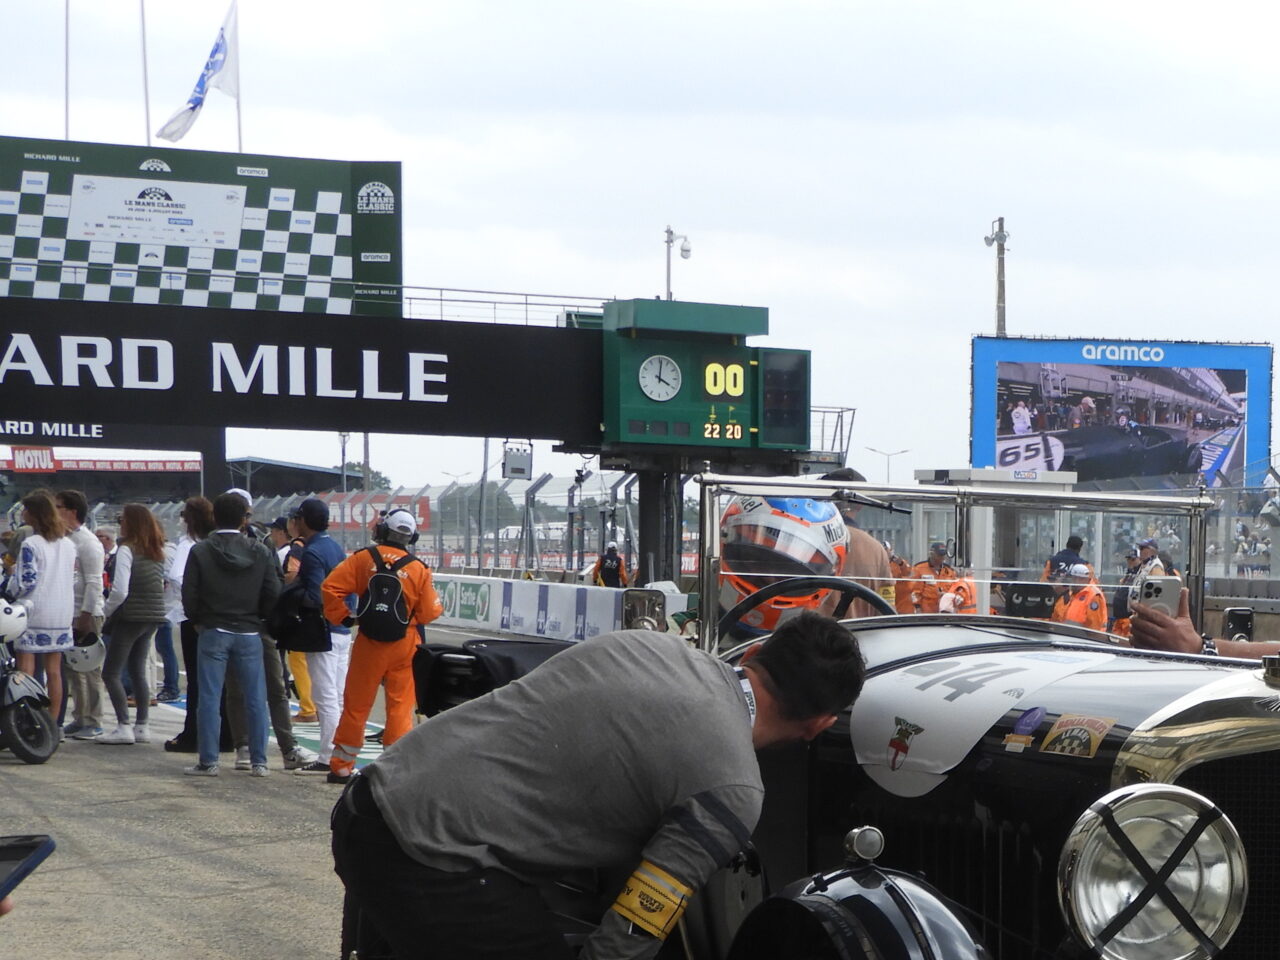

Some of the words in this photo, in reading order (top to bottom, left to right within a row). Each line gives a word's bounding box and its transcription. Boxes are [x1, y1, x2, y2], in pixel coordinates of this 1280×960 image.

[1082, 344, 1164, 361] aramco
[211, 342, 448, 402] MILLE
[705, 363, 744, 397] 00
[41, 422, 104, 438] MILLE
[704, 423, 720, 438] 22
[725, 424, 742, 439] 20
[14, 449, 54, 469] MOTUL
[1000, 442, 1041, 467] 65
